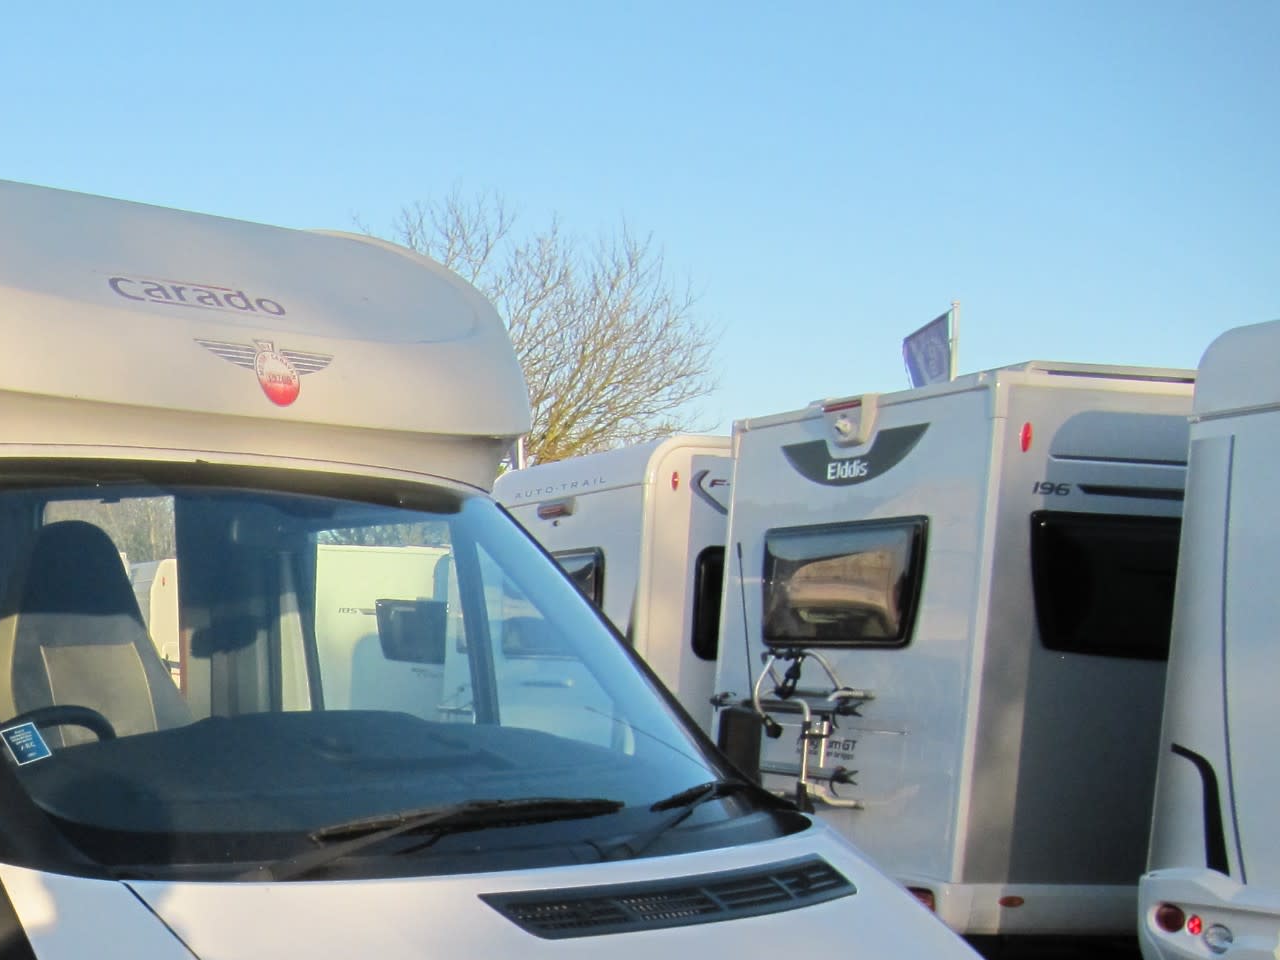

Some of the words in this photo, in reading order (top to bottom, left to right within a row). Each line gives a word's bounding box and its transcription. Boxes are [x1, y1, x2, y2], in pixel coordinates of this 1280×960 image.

[108, 276, 286, 316] Carado
[826, 459, 869, 480] Elddis
[1032, 481, 1072, 496] 196
